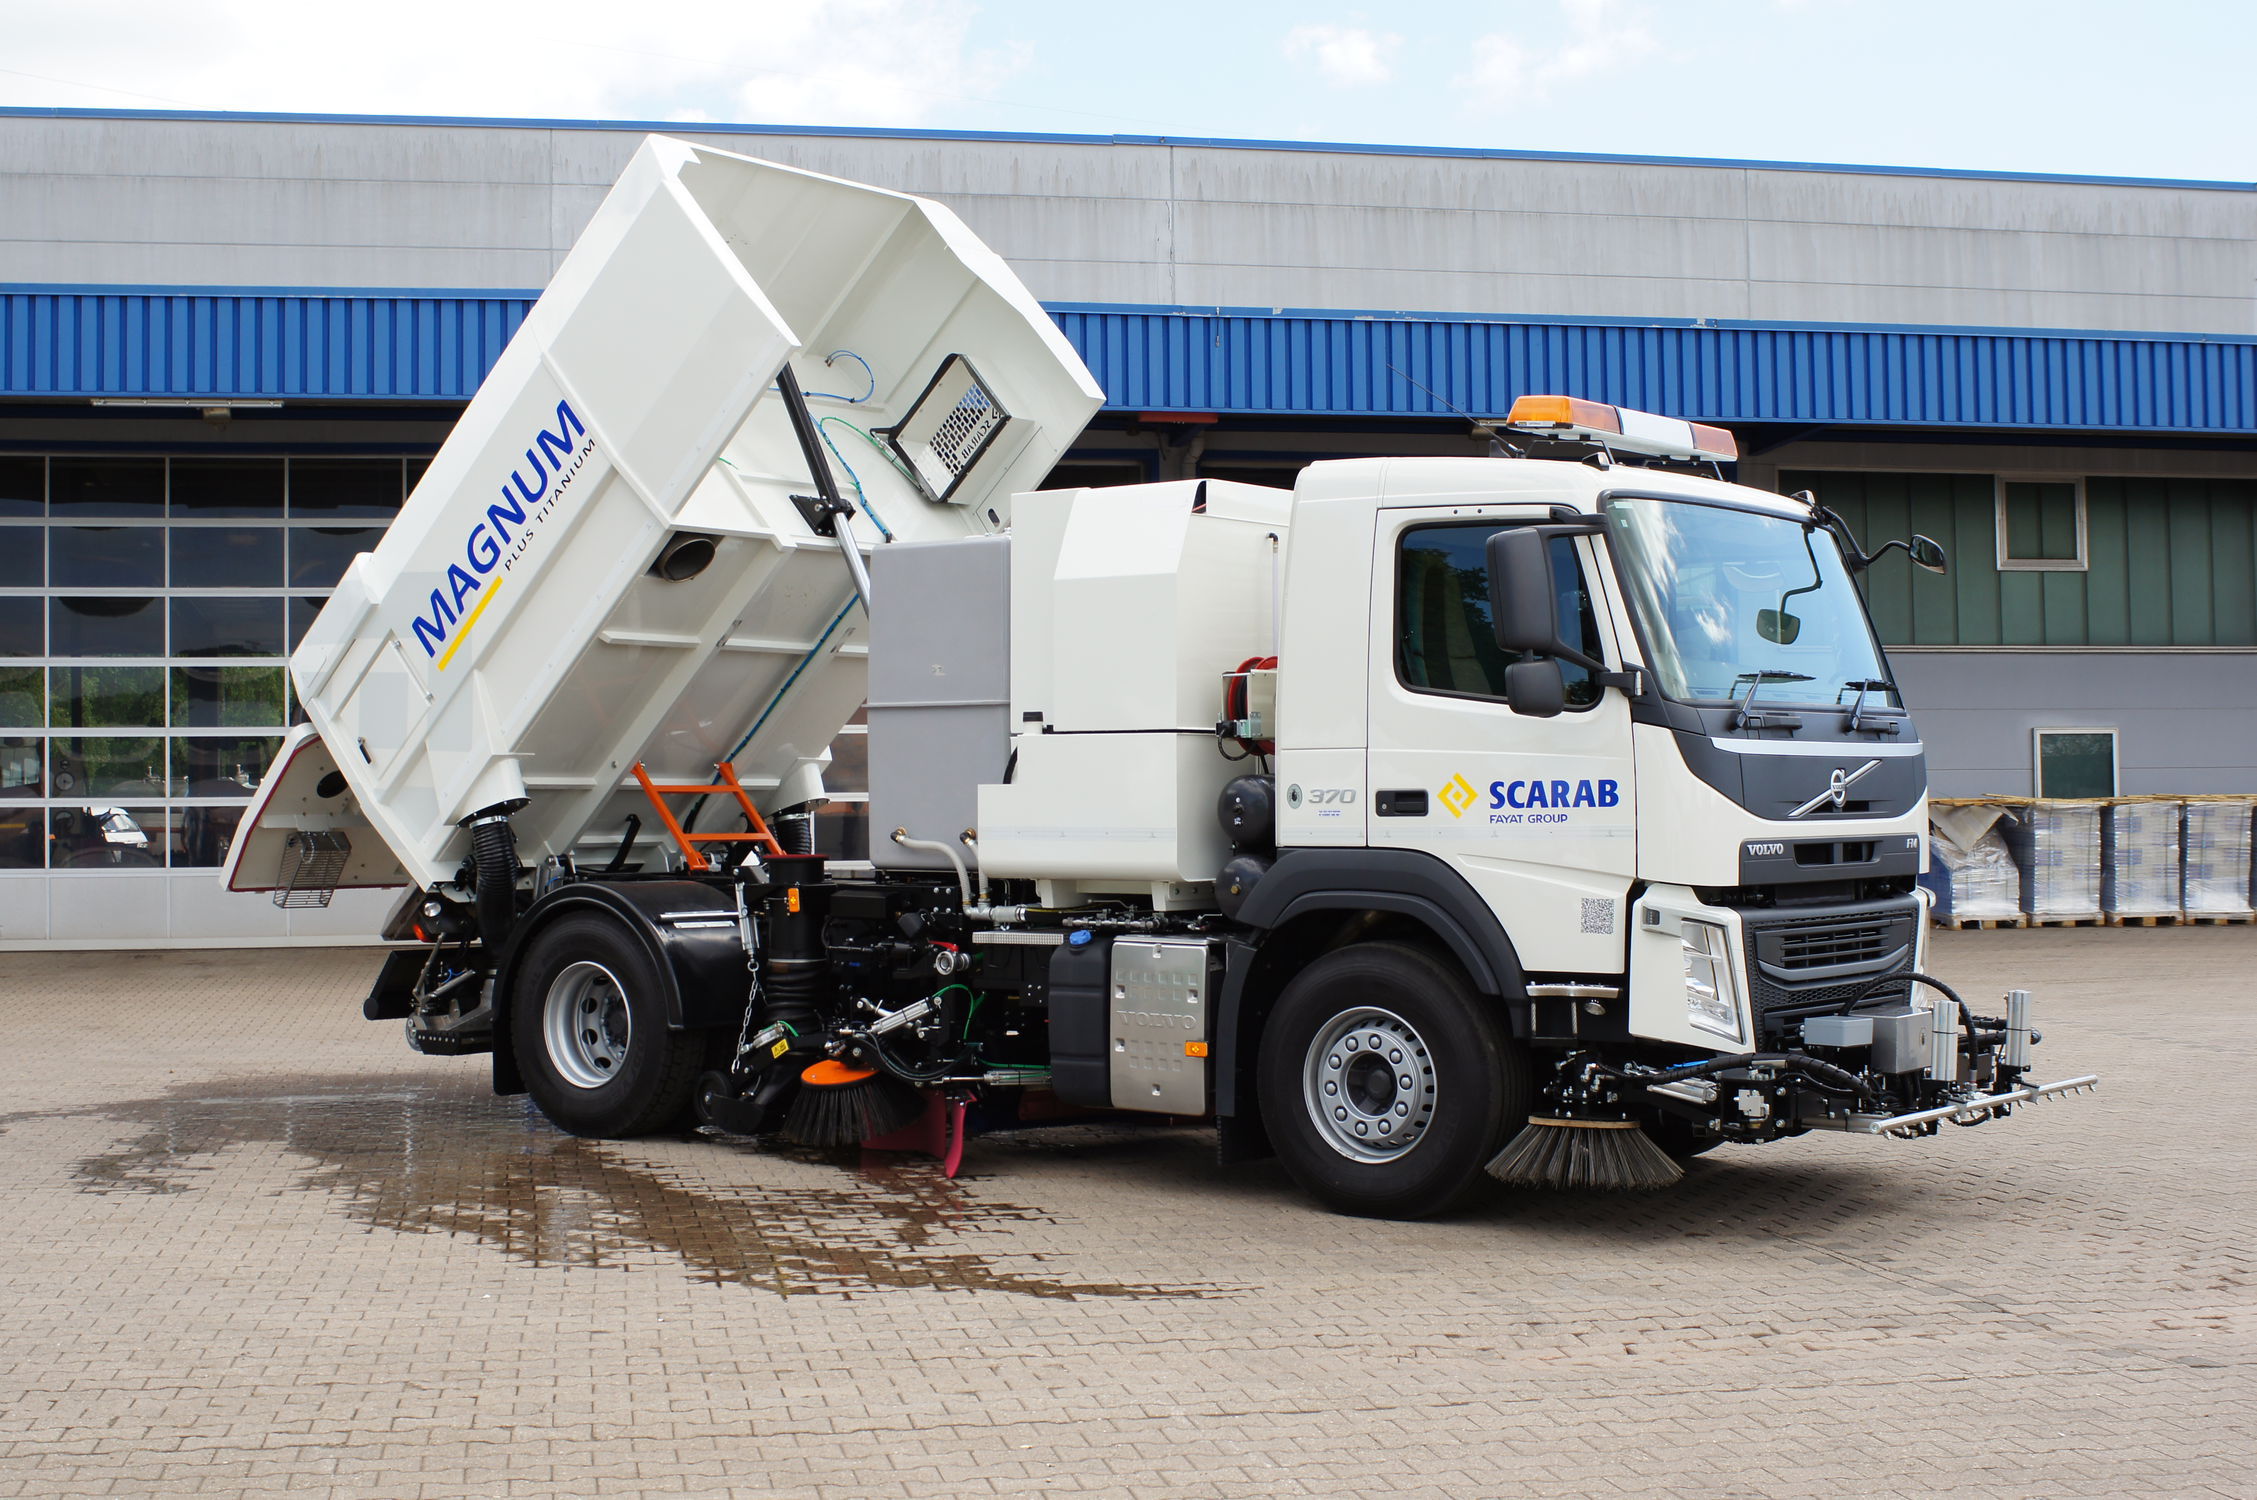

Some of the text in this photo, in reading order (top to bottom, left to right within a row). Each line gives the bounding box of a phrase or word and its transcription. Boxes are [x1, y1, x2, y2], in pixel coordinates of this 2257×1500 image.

[504, 438, 596, 572] PLUS TITANIUM
[412, 399, 586, 658] MAGNUM
[1308, 789, 1357, 804] 370
[1489, 779, 1619, 809] SCARAB
[1489, 813, 1568, 824] FAYAT GROUP
[1747, 843, 1784, 855] VOLVO
[1116, 1010, 1197, 1029] VOLVO
